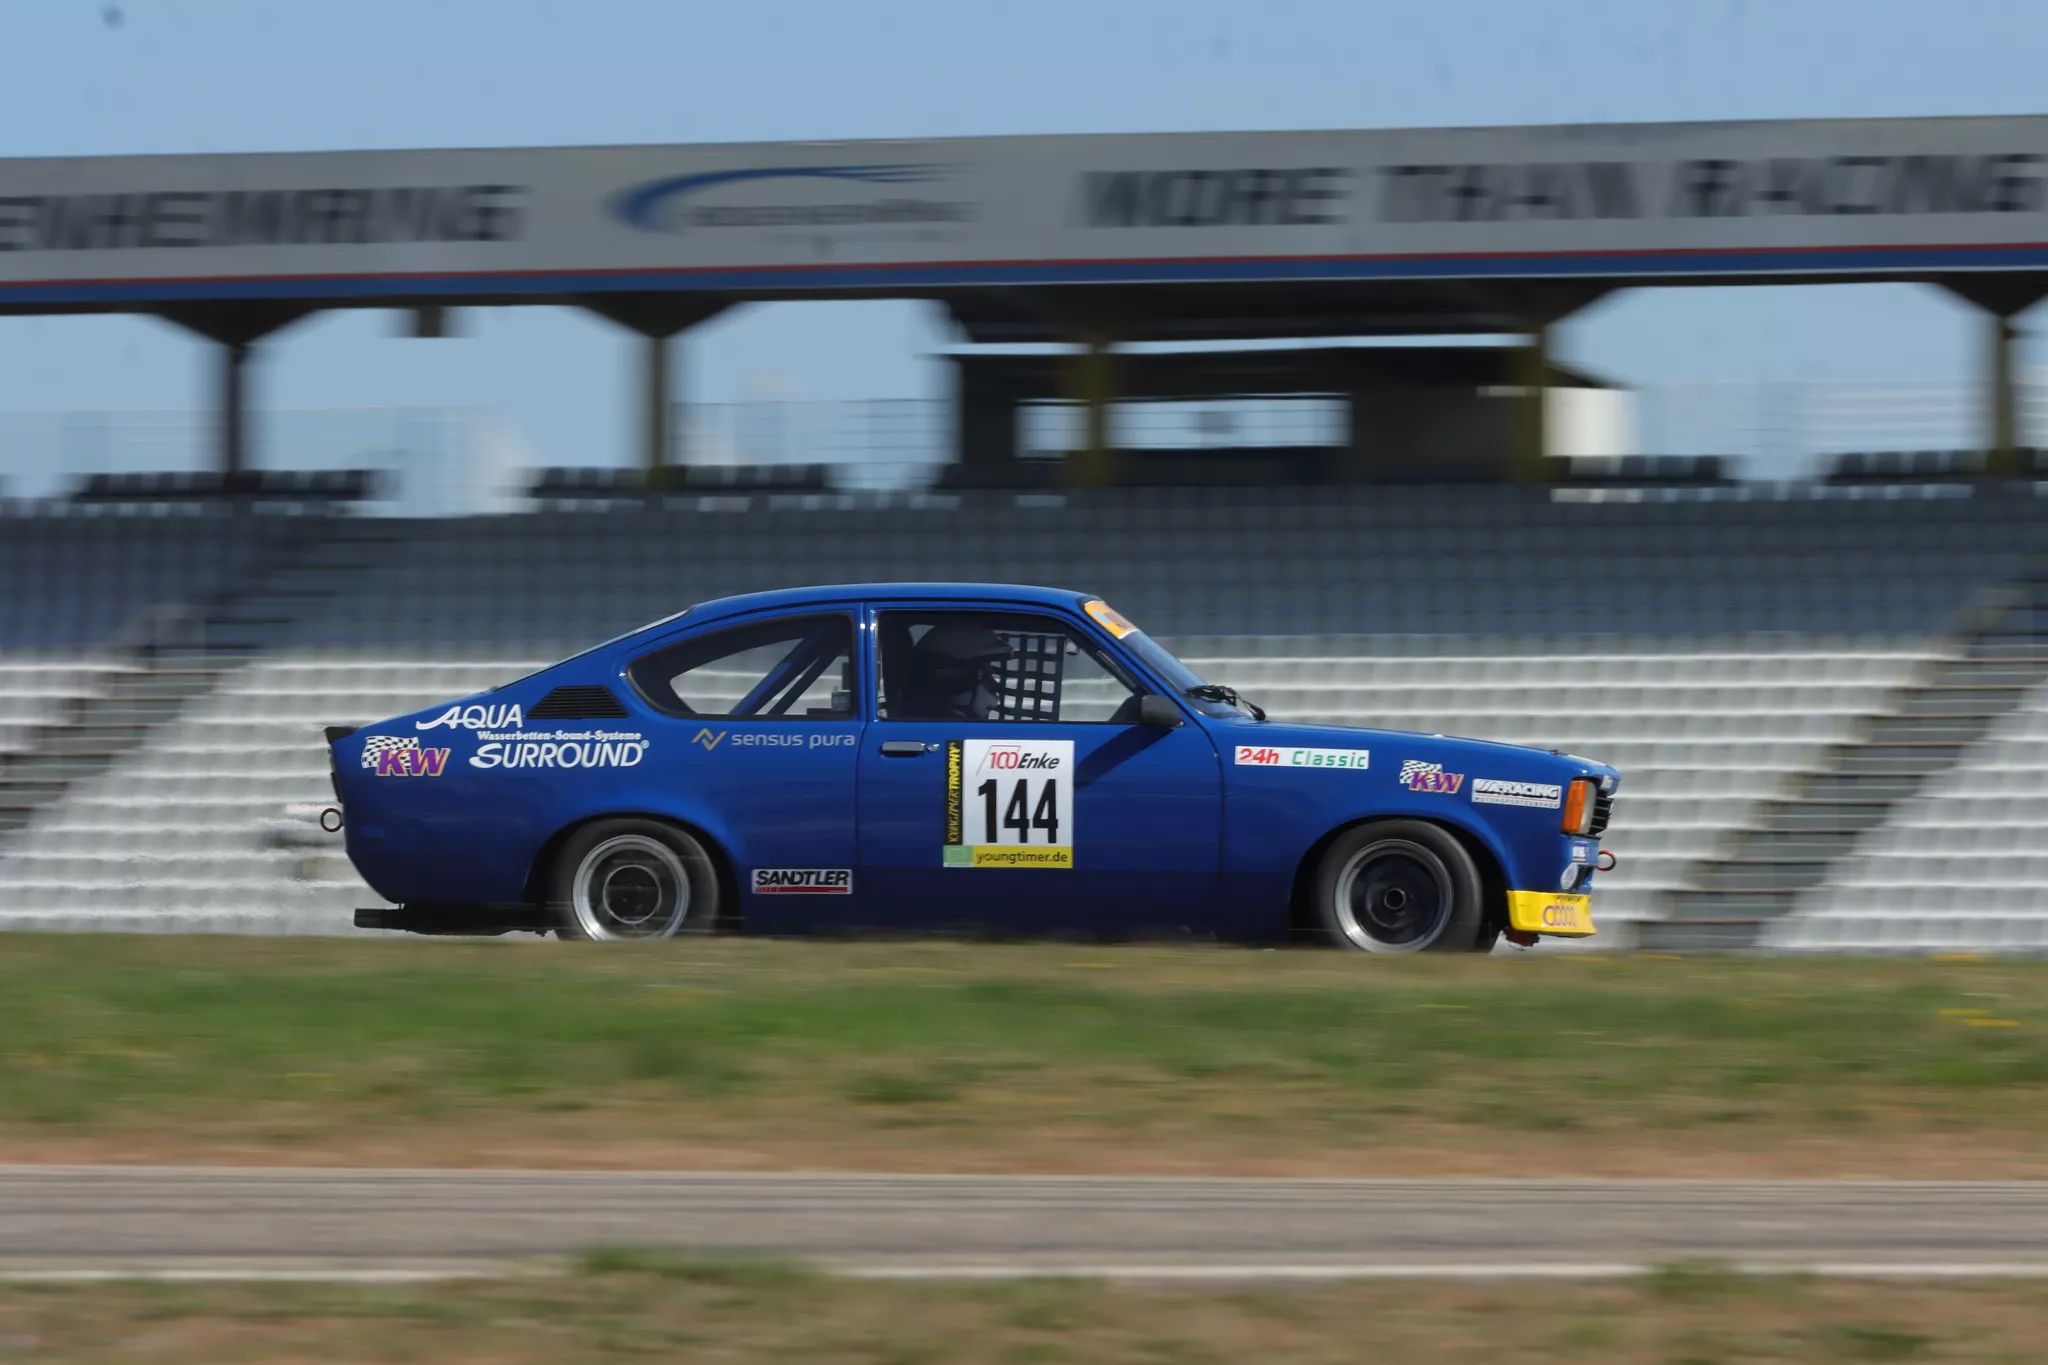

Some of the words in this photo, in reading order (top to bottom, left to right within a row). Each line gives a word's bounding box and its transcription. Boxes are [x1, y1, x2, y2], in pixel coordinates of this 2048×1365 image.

[415, 704, 524, 730] AQUA
[731, 733, 804, 746] sensus
[809, 734, 856, 749] pura
[376, 748, 451, 776] KW
[1239, 748, 1280, 764] 24h
[1291, 750, 1366, 767] Classic
[1408, 771, 1465, 794] KW
[978, 779, 1059, 844] 144
[976, 851, 1068, 864] youngtimer.de
[756, 870, 849, 886] SANDTLER
